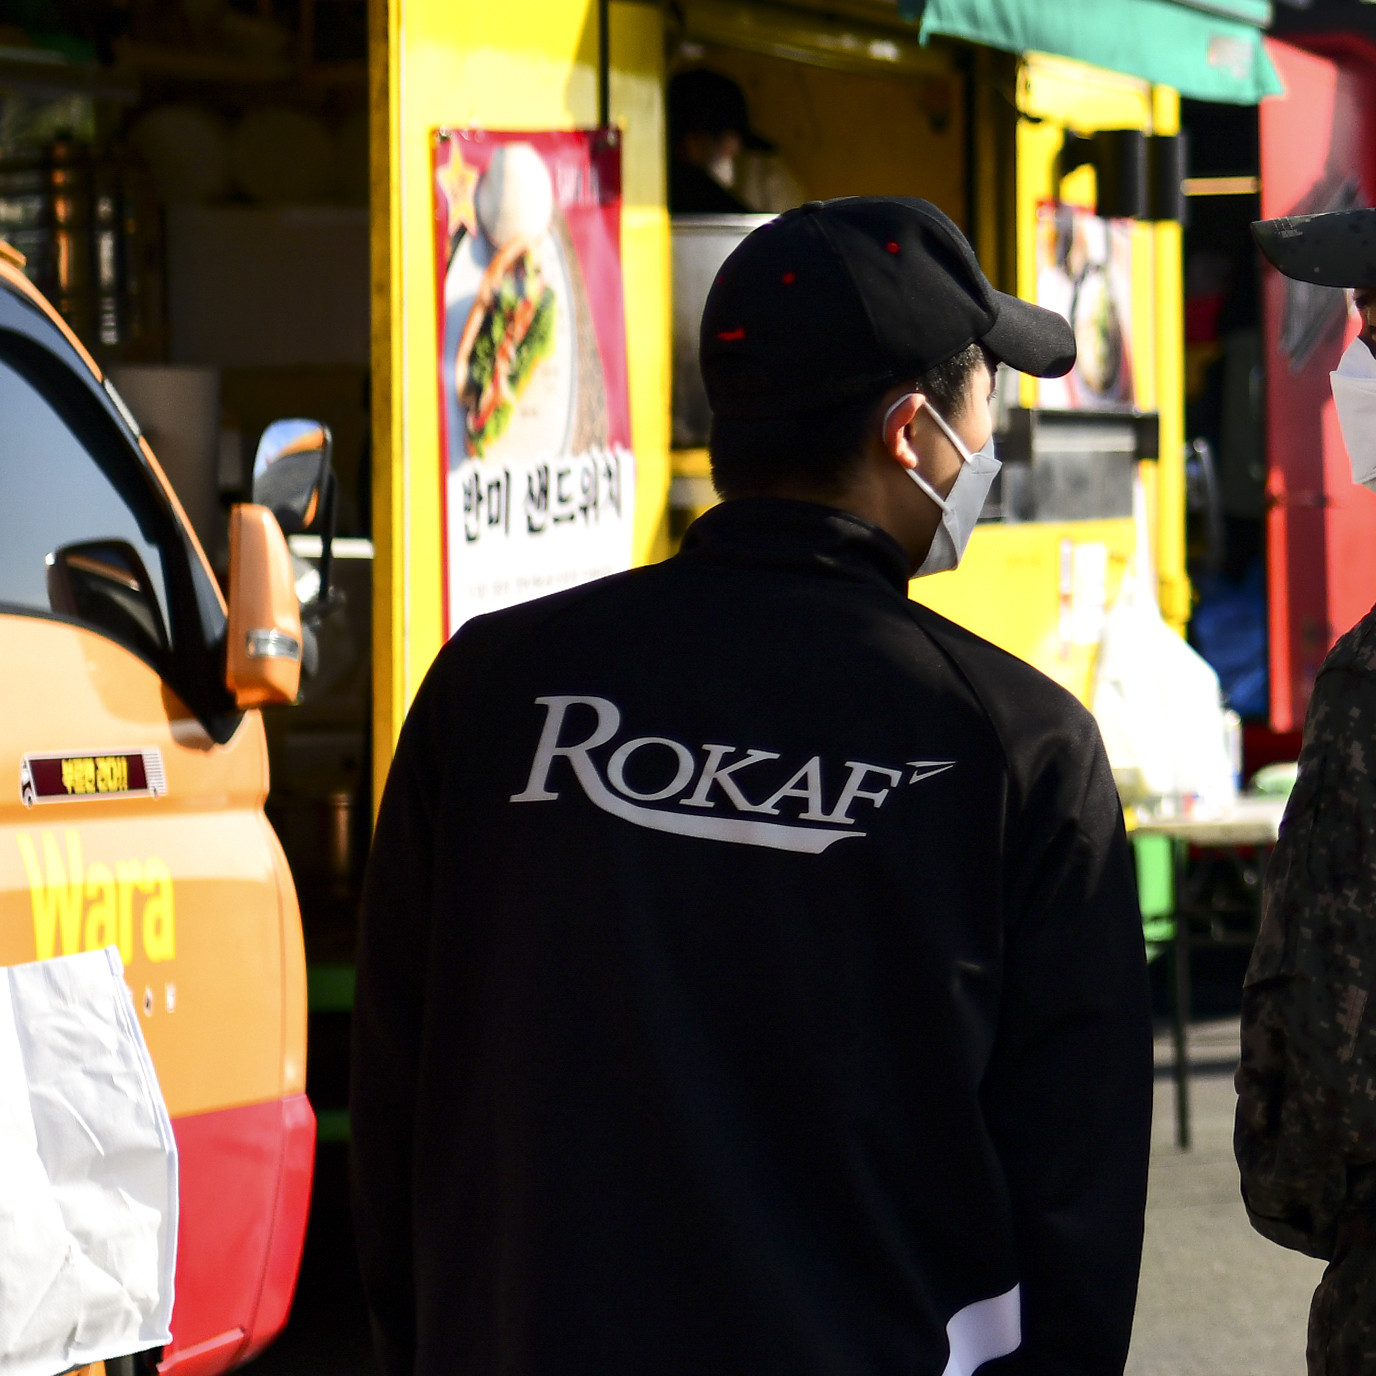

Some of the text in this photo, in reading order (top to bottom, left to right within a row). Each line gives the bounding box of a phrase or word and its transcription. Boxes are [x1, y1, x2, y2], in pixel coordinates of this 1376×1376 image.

[463, 455, 622, 543] 반미 샌드위치
[509, 694, 904, 855] ROKAF
[16, 828, 175, 966] Wara
